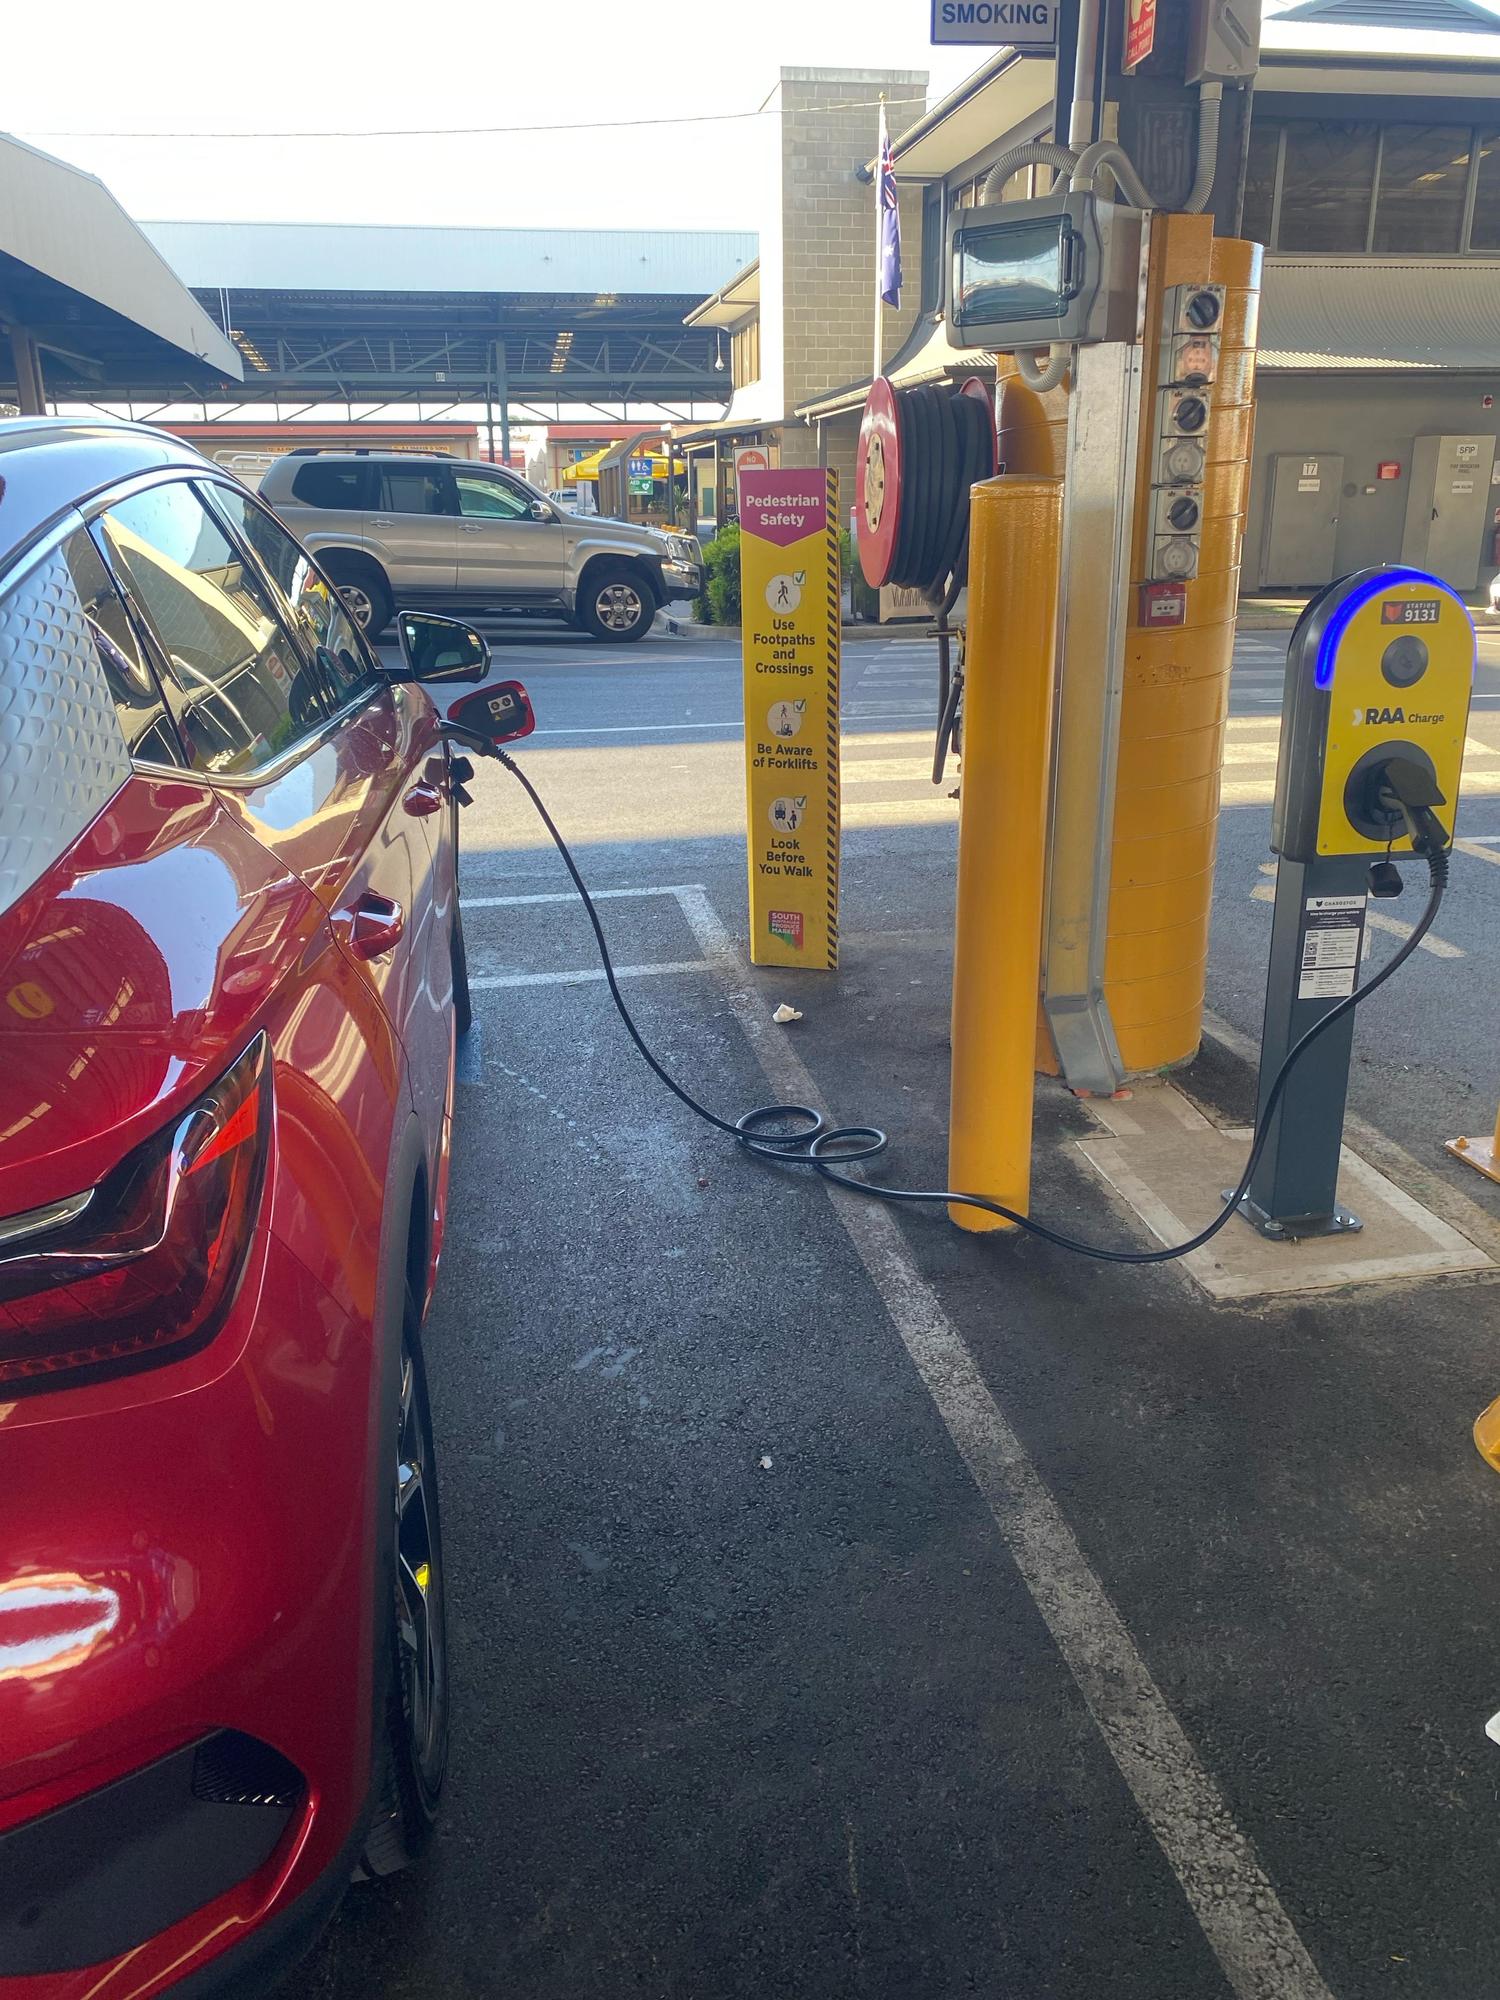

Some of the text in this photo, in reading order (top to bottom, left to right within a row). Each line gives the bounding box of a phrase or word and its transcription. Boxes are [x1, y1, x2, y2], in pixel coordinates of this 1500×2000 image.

[942, 3, 1048, 24] SMOKING
[745, 494, 820, 507] Pedestrian
[760, 513, 805, 527] Safety
[1404, 609, 1437, 622] 9131
[772, 618, 795, 631] Use
[753, 633, 816, 647] Footpaths
[772, 647, 796, 660] and
[755, 662, 814, 677] Crossings
[1365, 707, 1445, 725] RAA Charge
[757, 743, 813, 756] Be Aware
[753, 756, 818, 770] of Forklifts
[771, 837, 801, 850] Look
[766, 851, 806, 863] Before
[758, 863, 814, 878] You Walk
[771, 912, 801, 921] SOUTH
